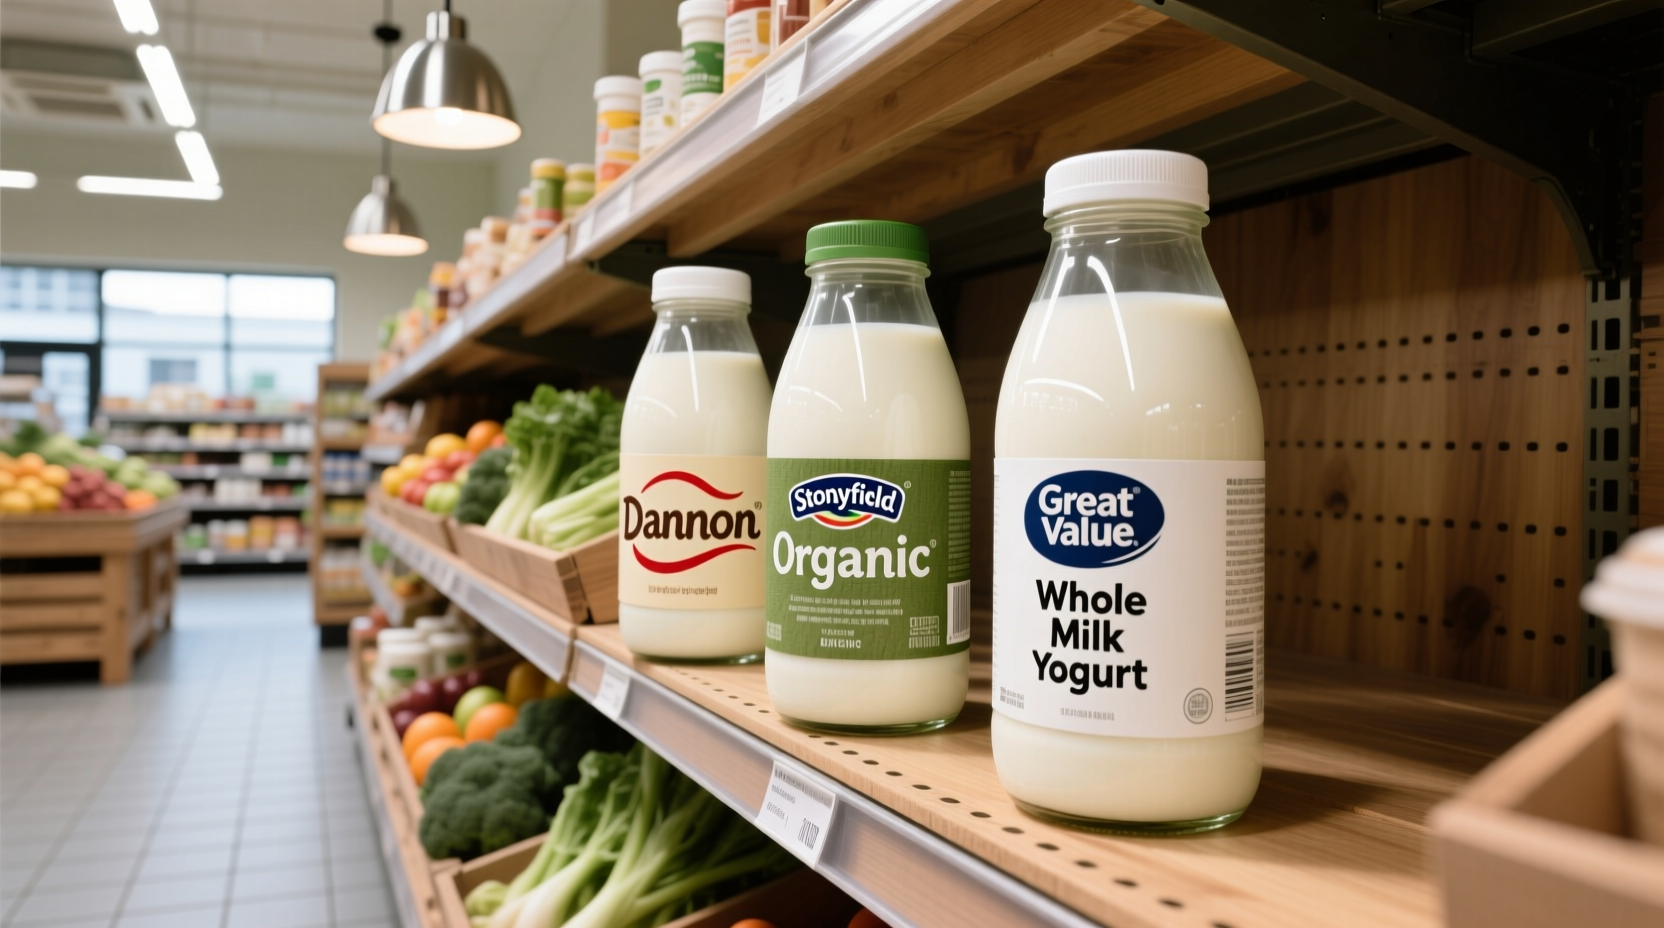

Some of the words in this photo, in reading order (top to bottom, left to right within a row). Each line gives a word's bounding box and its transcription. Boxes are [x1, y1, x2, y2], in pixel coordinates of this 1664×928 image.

[623, 495, 761, 541] Dannon
[1038, 484, 1134, 518] Great
[773, 530, 930, 590] Organic
[1035, 579, 1147, 616] Whole
[1051, 617, 1125, 653] Milk
[1032, 650, 1148, 695] Yogurt
